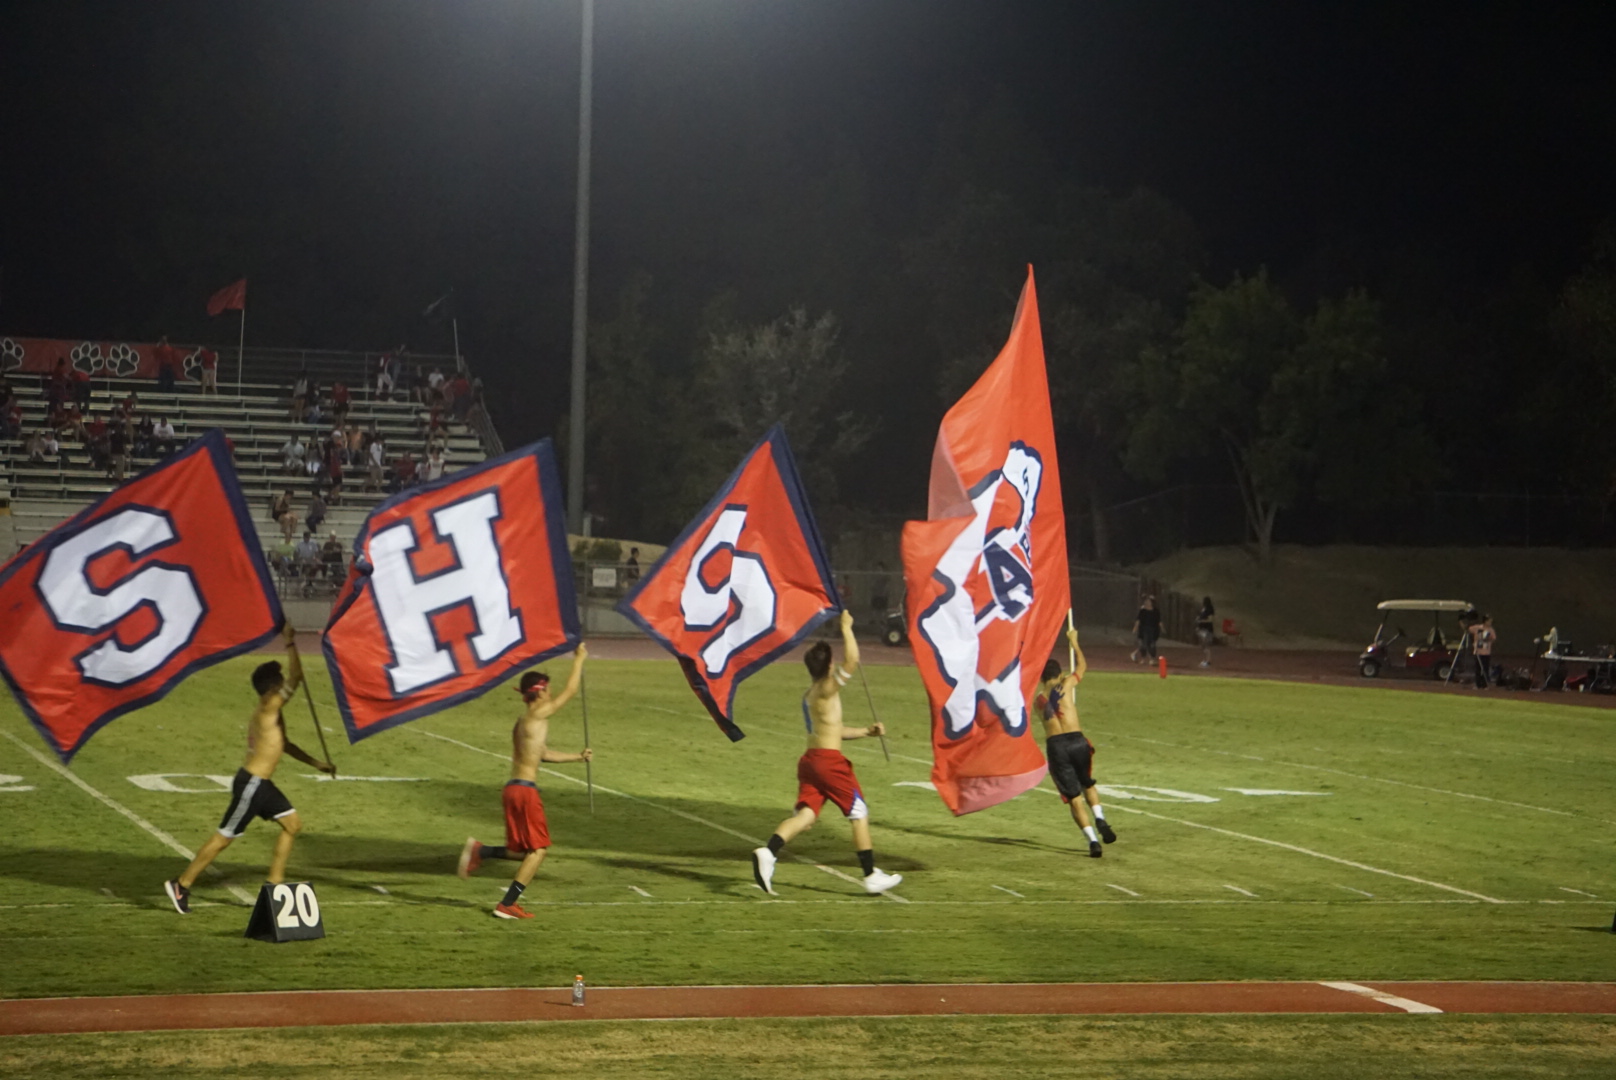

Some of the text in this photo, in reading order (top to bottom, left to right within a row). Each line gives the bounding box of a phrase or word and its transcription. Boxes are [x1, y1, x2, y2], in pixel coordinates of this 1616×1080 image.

[36, 507, 205, 684] S
[366, 490, 524, 694] H
[273, 884, 320, 928] 20
